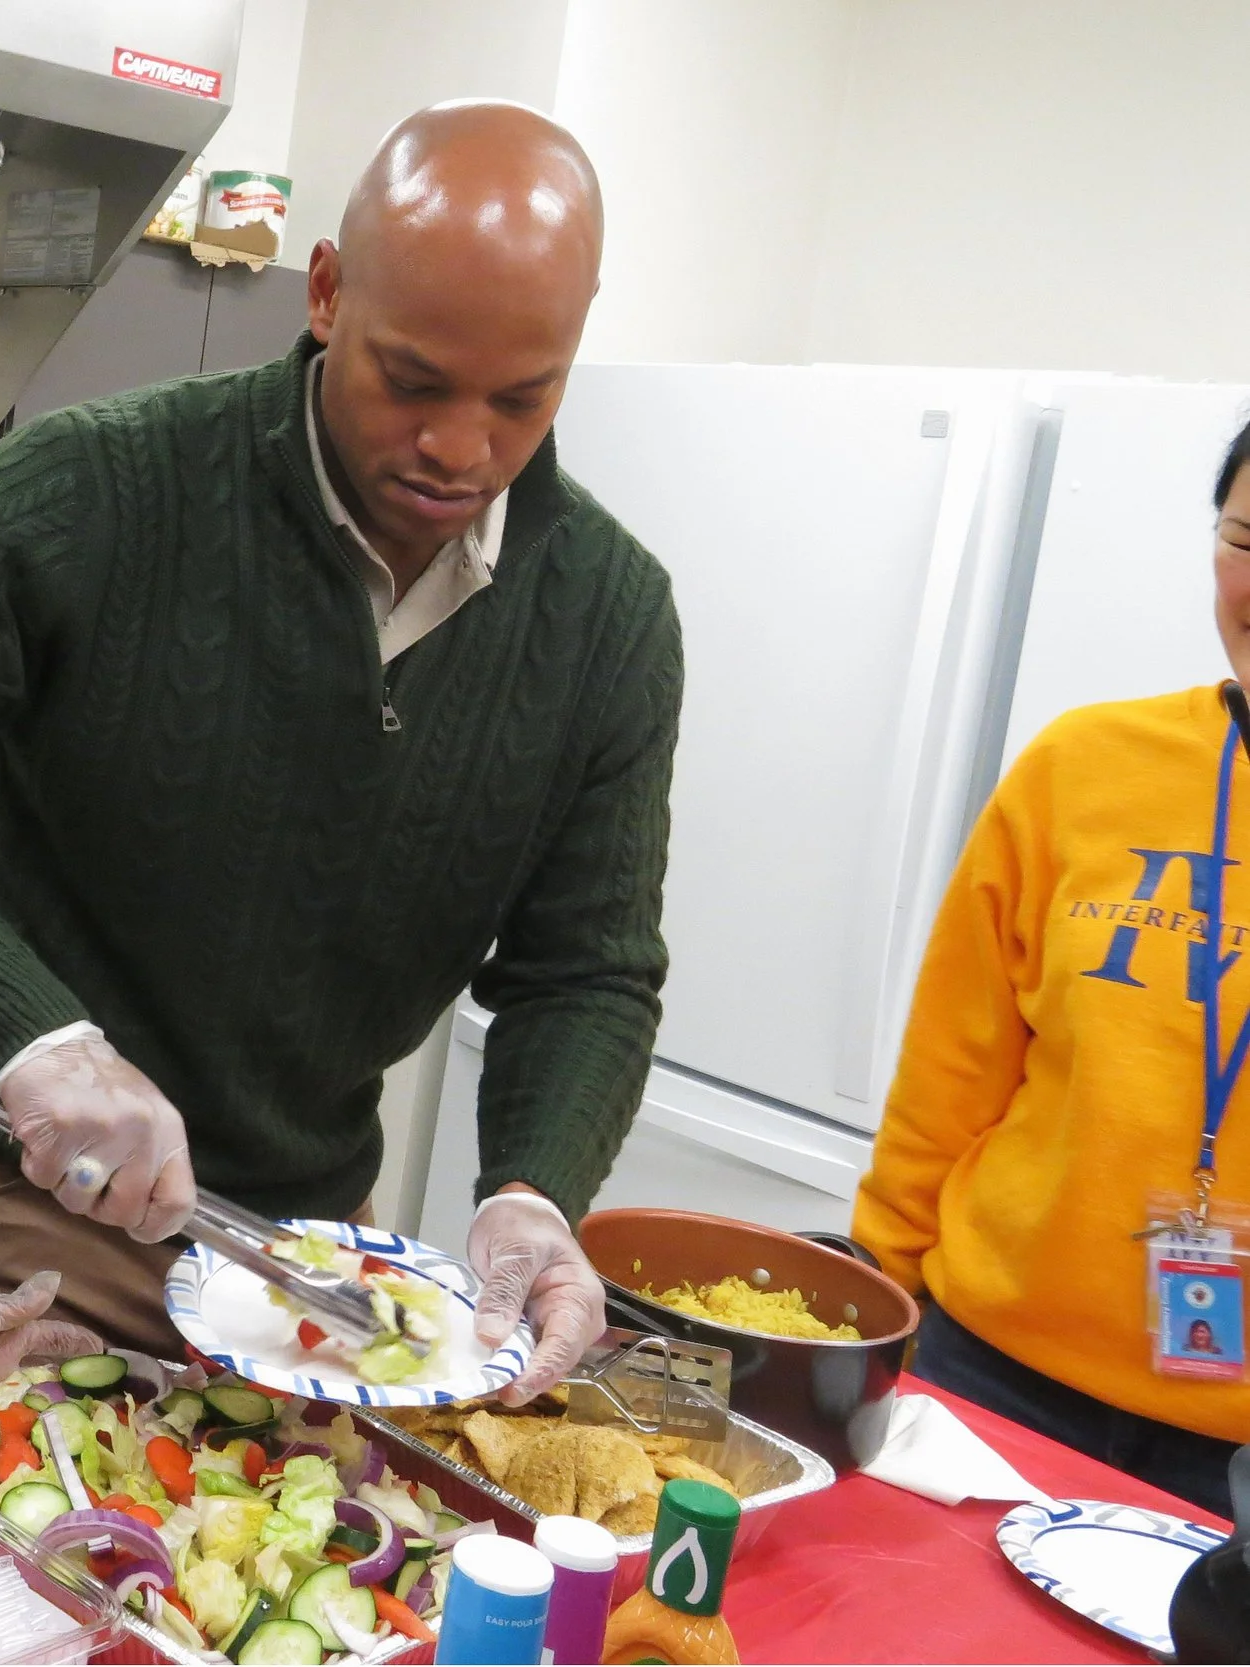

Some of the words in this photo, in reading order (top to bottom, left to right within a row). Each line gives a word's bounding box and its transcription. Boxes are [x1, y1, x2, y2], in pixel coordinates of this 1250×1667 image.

[117, 51, 217, 93] CAPTIVEAIRE
[1068, 901, 1250, 947] INTERFAT
[485, 1615, 510, 1627] EASY
[510, 1618, 534, 1629] POUR
